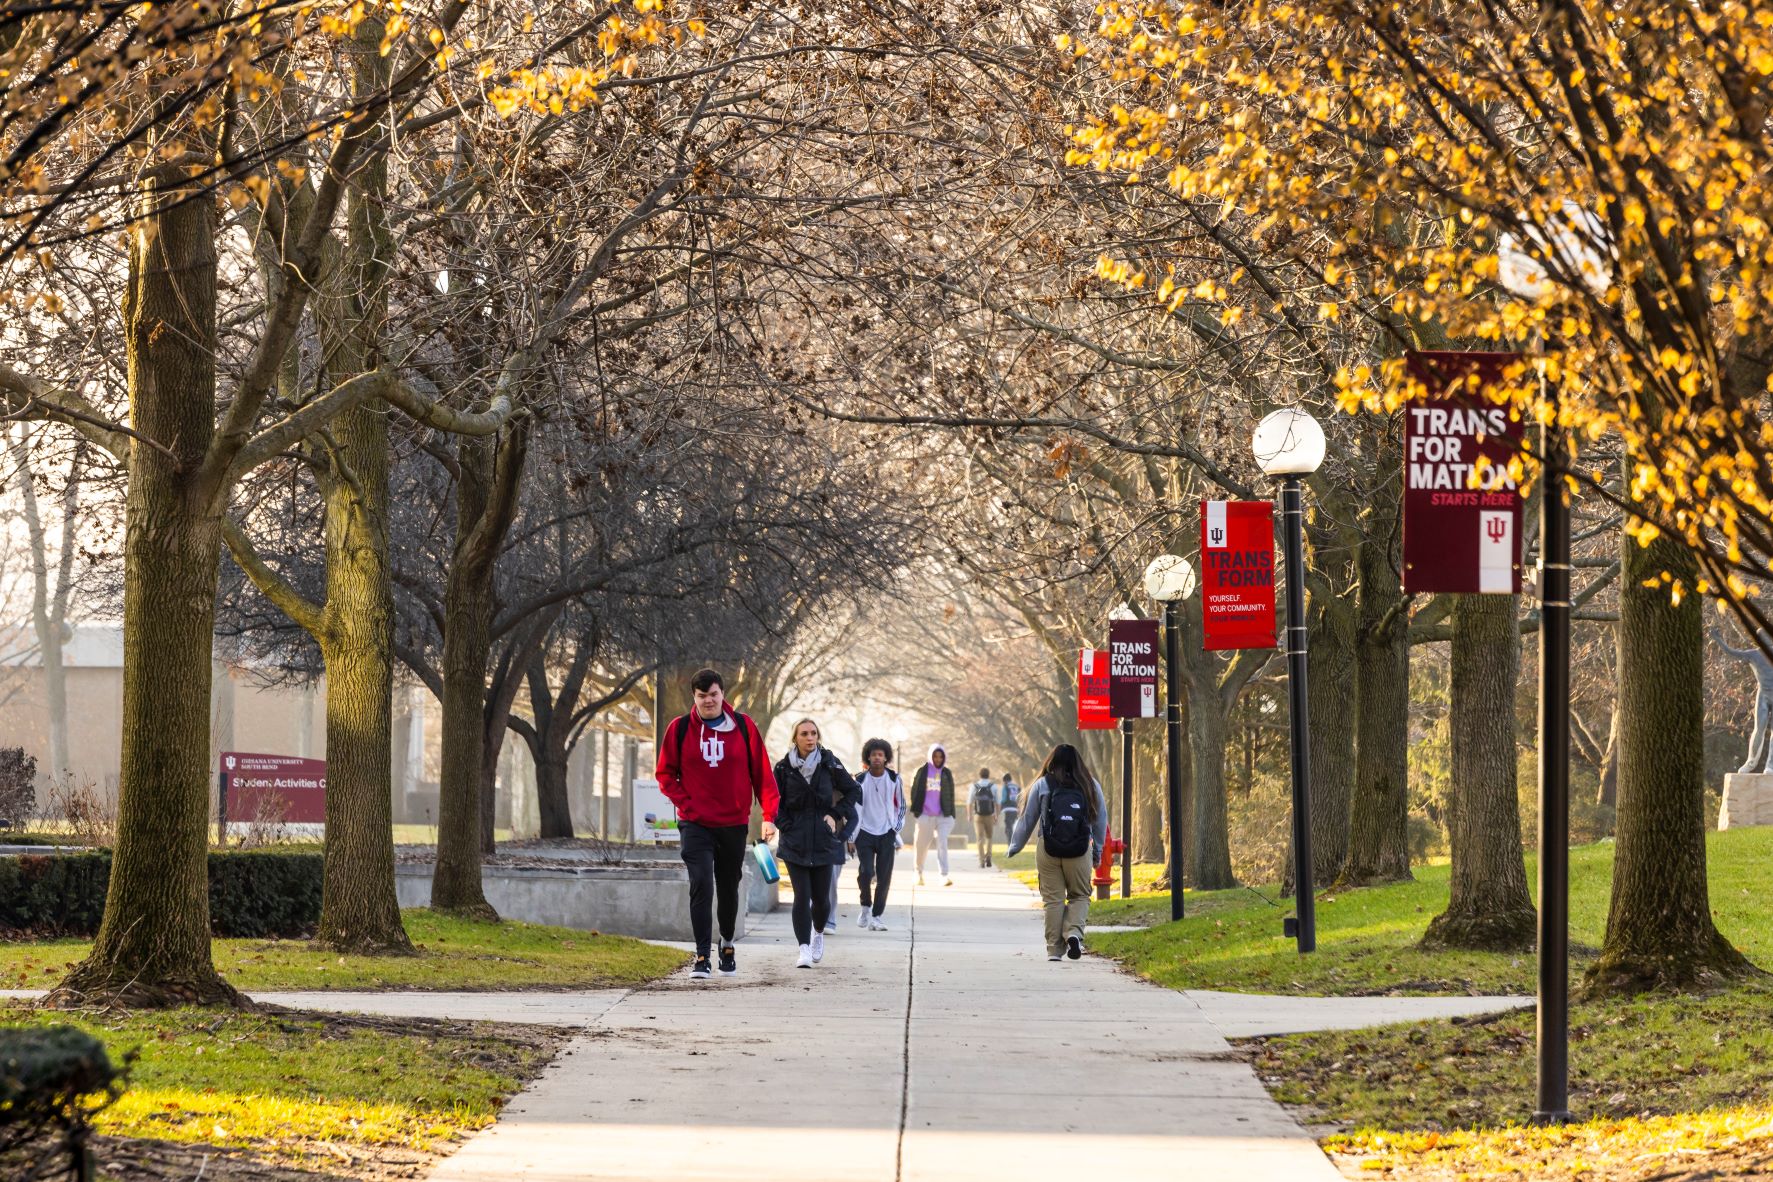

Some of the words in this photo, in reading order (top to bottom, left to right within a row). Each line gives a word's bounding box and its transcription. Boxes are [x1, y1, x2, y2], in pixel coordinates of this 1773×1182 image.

[1411, 408, 1507, 436] TRANS
[1410, 436, 1462, 462] FOR
[1431, 493, 1478, 506] STARTS
[1481, 493, 1515, 506] HERE
[1207, 550, 1271, 569] TRANS
[1218, 569, 1272, 587] FORM
[1227, 604, 1267, 612] COMMUNITY.
[1112, 642, 1151, 654] TRANS
[1112, 654, 1133, 665] FOR
[1112, 665, 1155, 676] MATION
[274, 778, 317, 788] Activities
